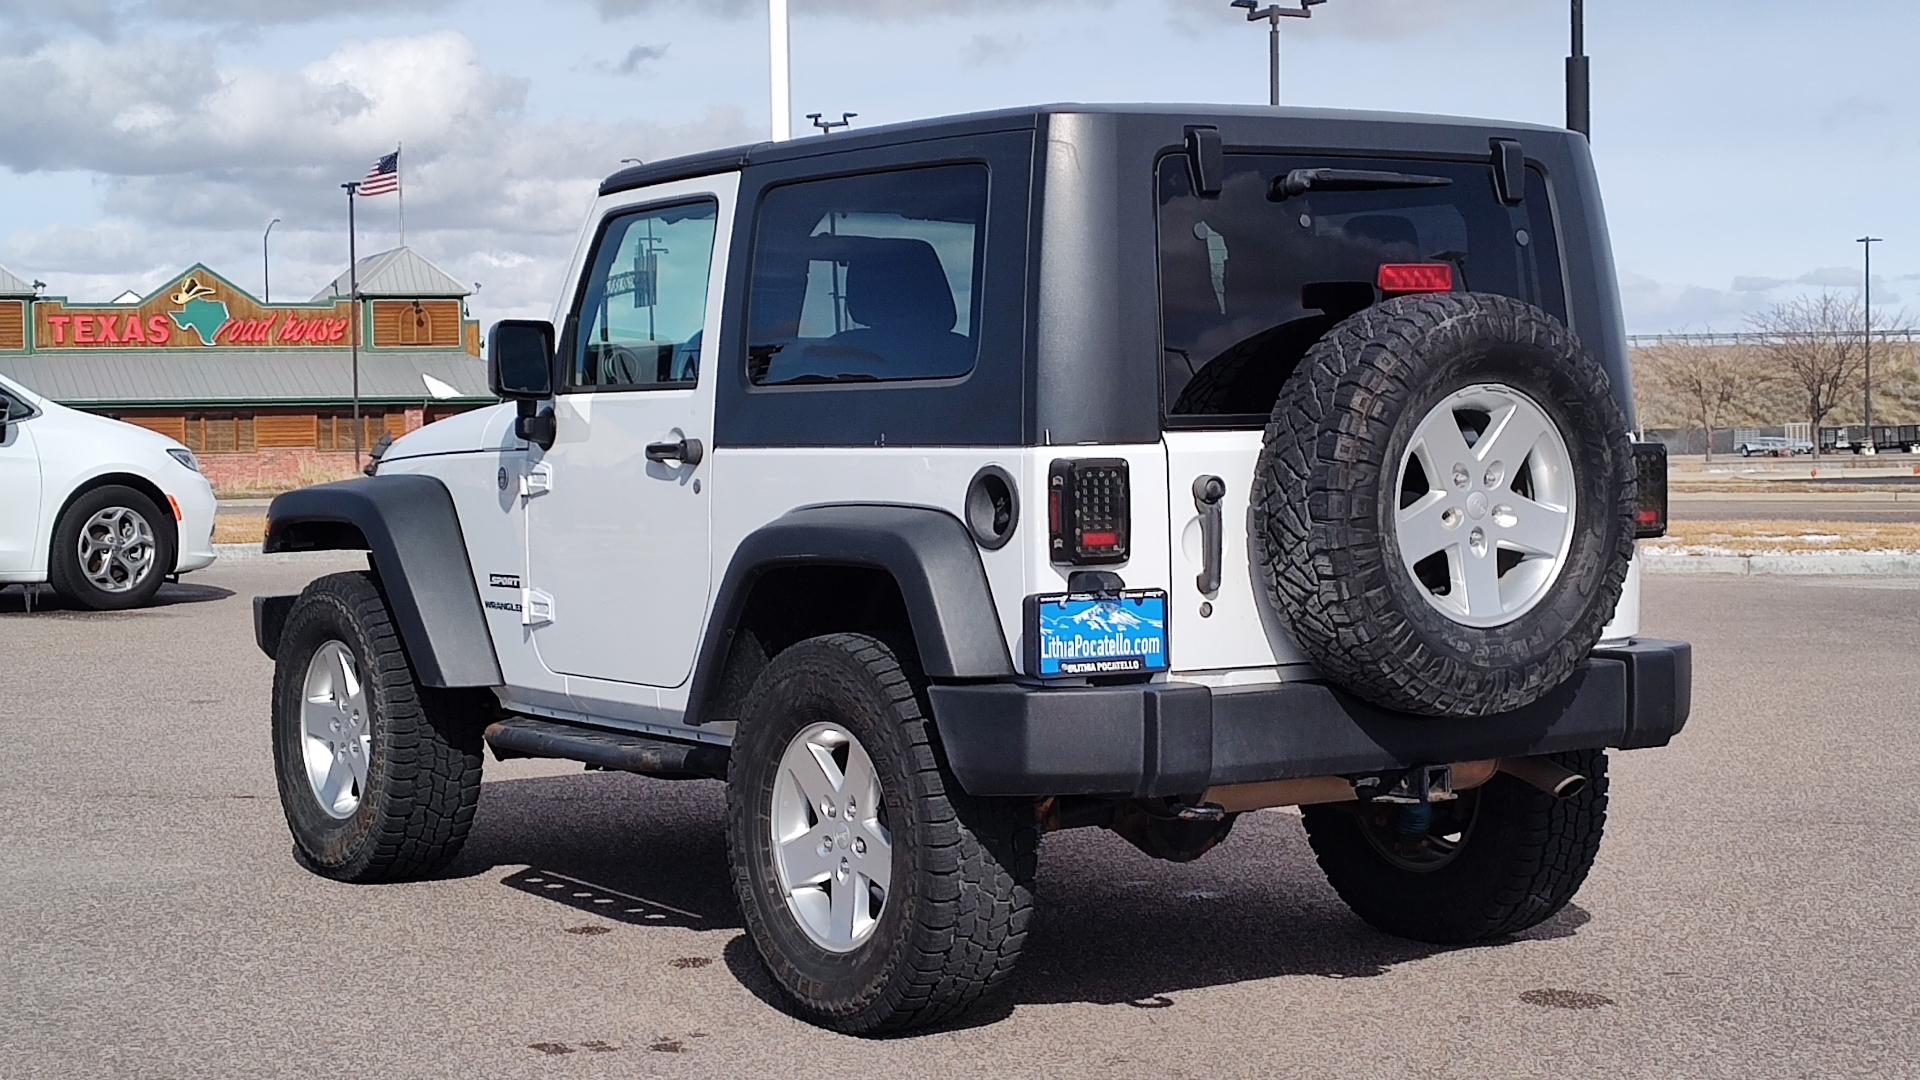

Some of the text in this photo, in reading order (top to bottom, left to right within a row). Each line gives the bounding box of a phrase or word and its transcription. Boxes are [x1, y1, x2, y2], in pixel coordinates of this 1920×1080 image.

[47, 310, 348, 344] TEXAS road house
[491, 575, 520, 586] SPORT
[1041, 632, 1160, 659] LithiaPocatello.com
[1097, 660, 1139, 671] POCATELLO
